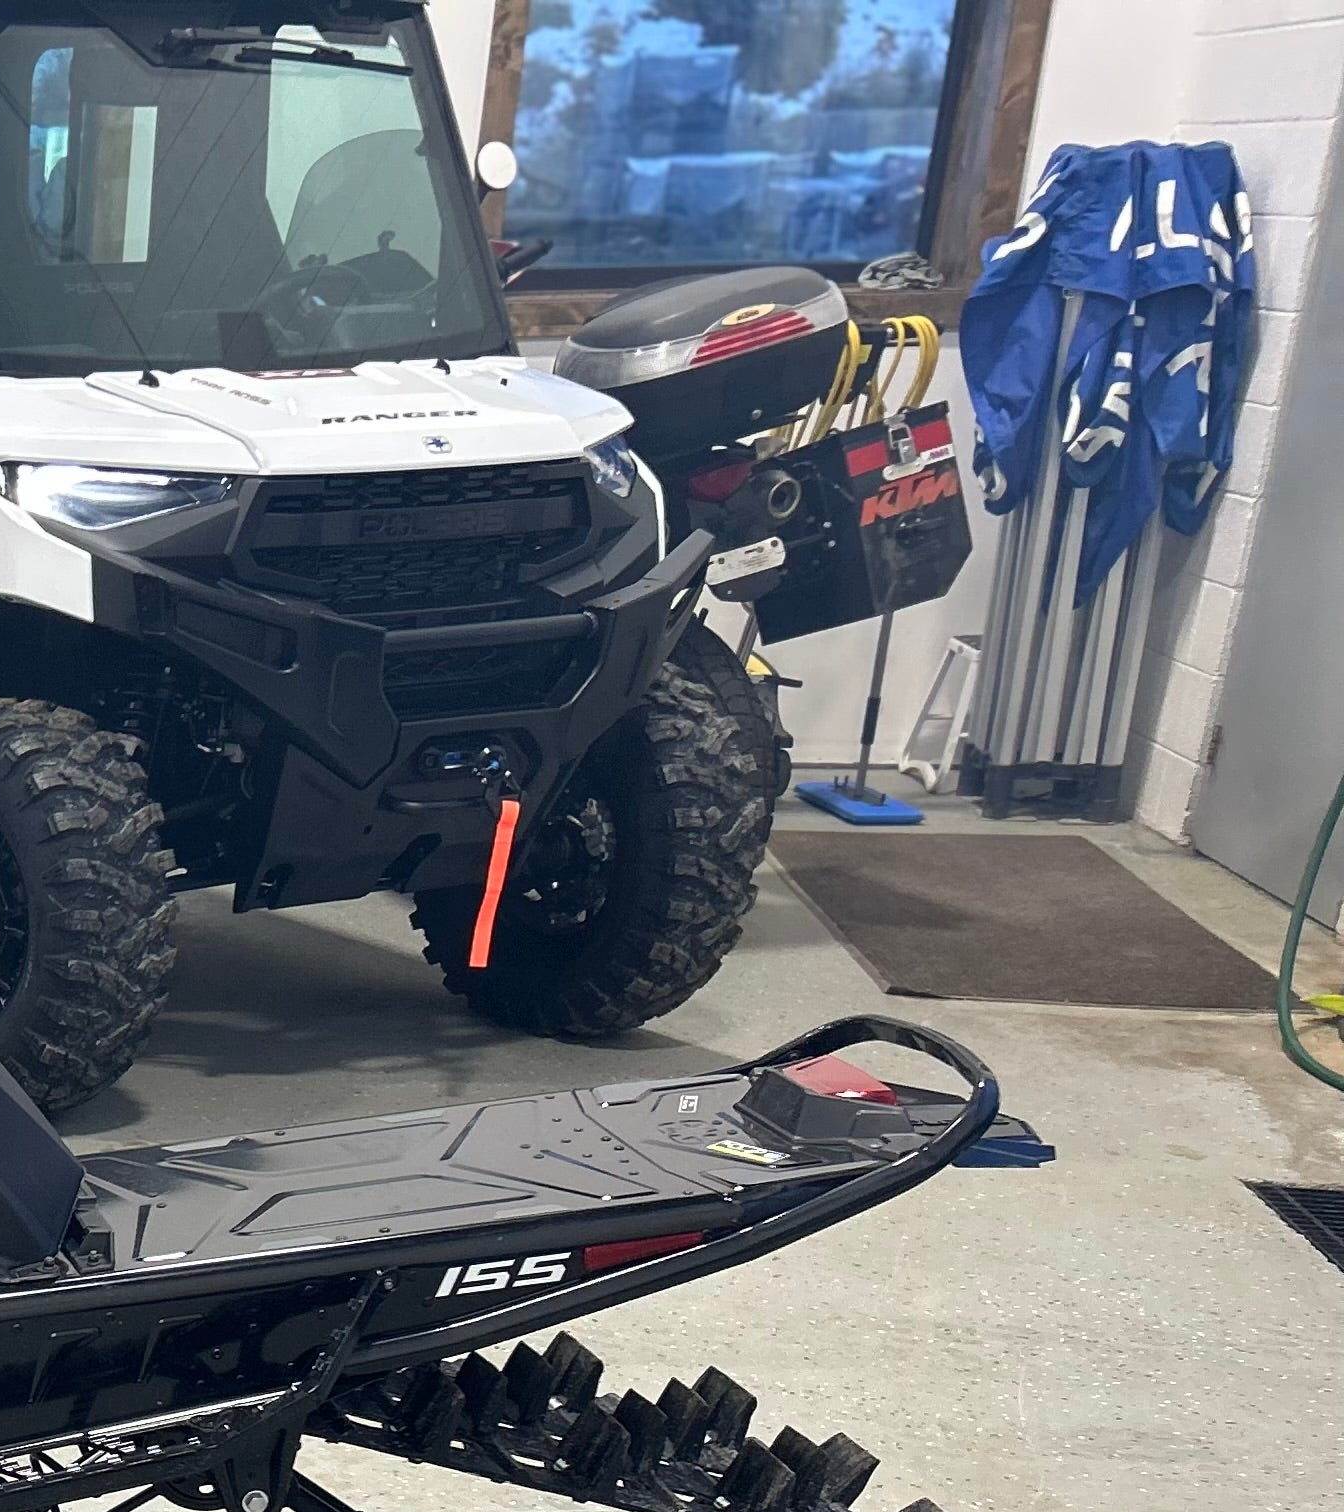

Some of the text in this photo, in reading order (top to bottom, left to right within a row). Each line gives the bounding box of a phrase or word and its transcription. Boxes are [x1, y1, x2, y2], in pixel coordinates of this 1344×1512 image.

[321, 410, 479, 426] RANGER
[858, 468, 960, 528] KTM
[434, 1252, 572, 1298] 155
